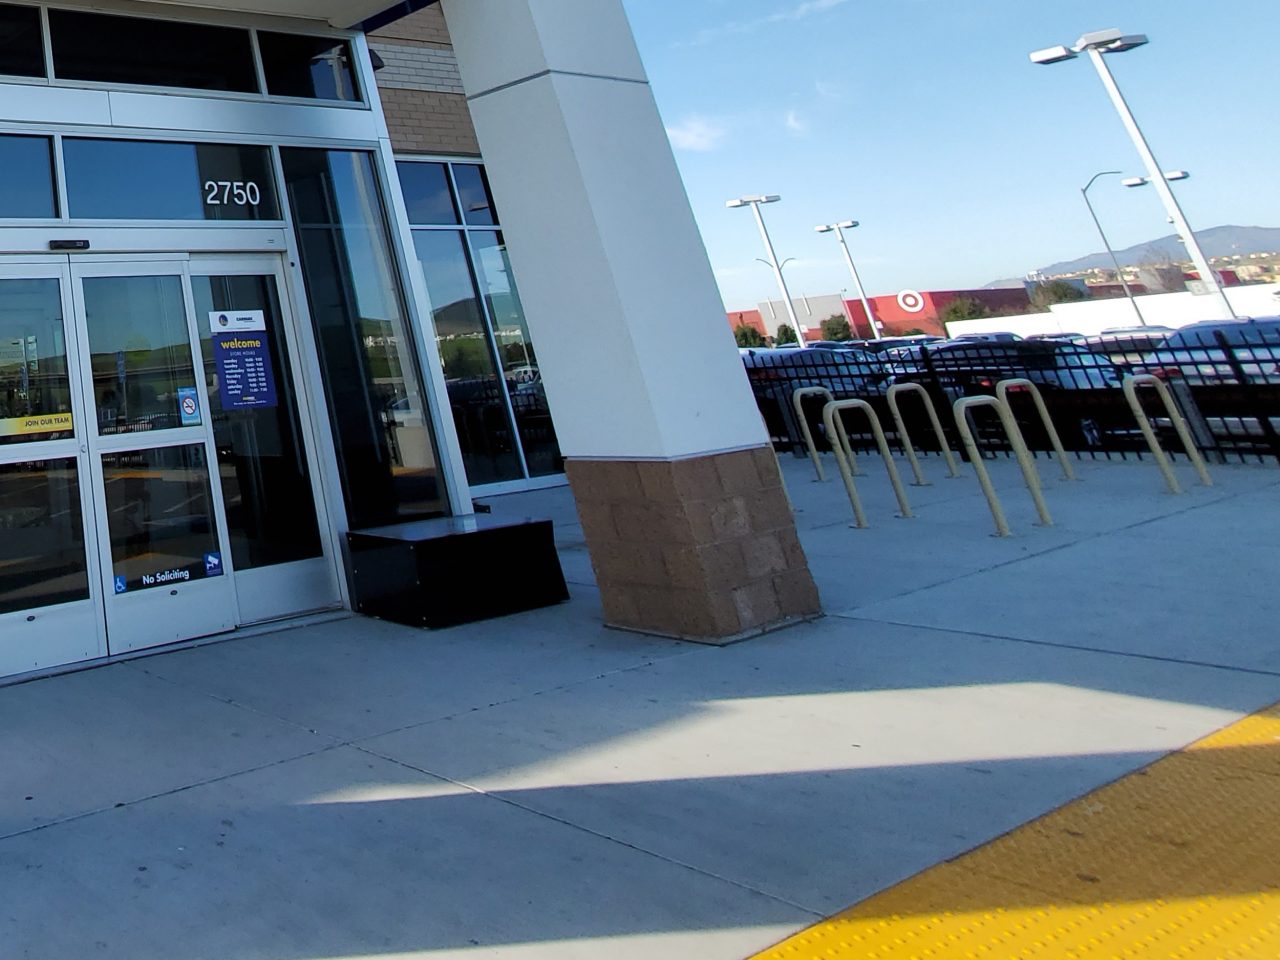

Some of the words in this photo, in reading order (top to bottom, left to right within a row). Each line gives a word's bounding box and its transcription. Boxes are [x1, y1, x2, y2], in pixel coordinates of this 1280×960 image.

[205, 181, 261, 206] 2750
[221, 338, 260, 349] welcome
[142, 574, 155, 585] No
[156, 569, 189, 582] Soliciting
